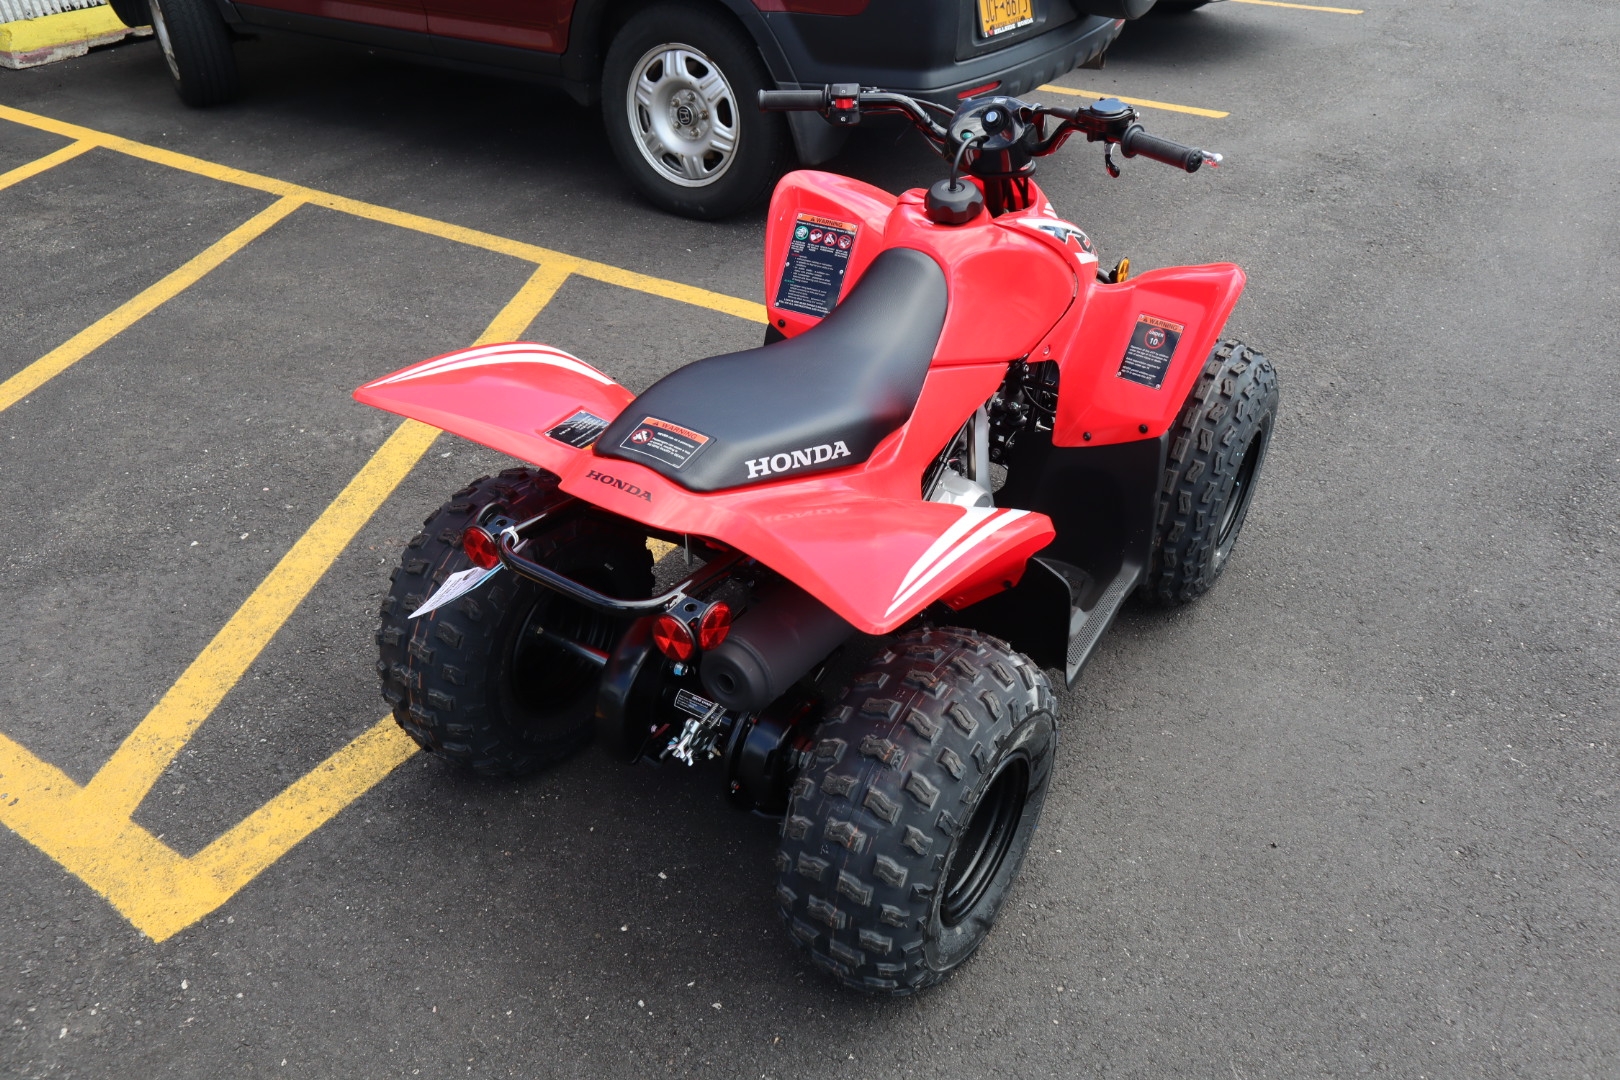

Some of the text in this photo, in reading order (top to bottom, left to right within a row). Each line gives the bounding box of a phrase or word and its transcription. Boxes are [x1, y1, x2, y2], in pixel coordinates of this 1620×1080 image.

[1017, 18, 1034, 28] HONDA
[816, 217, 843, 228] WARNING
[1149, 318, 1178, 331] WARNING
[1148, 330, 1164, 338] UNDER
[1149, 337, 1159, 346] 10
[661, 422, 698, 440] WARNING
[744, 440, 851, 479] HONDA
[585, 469, 652, 502] HONDA
